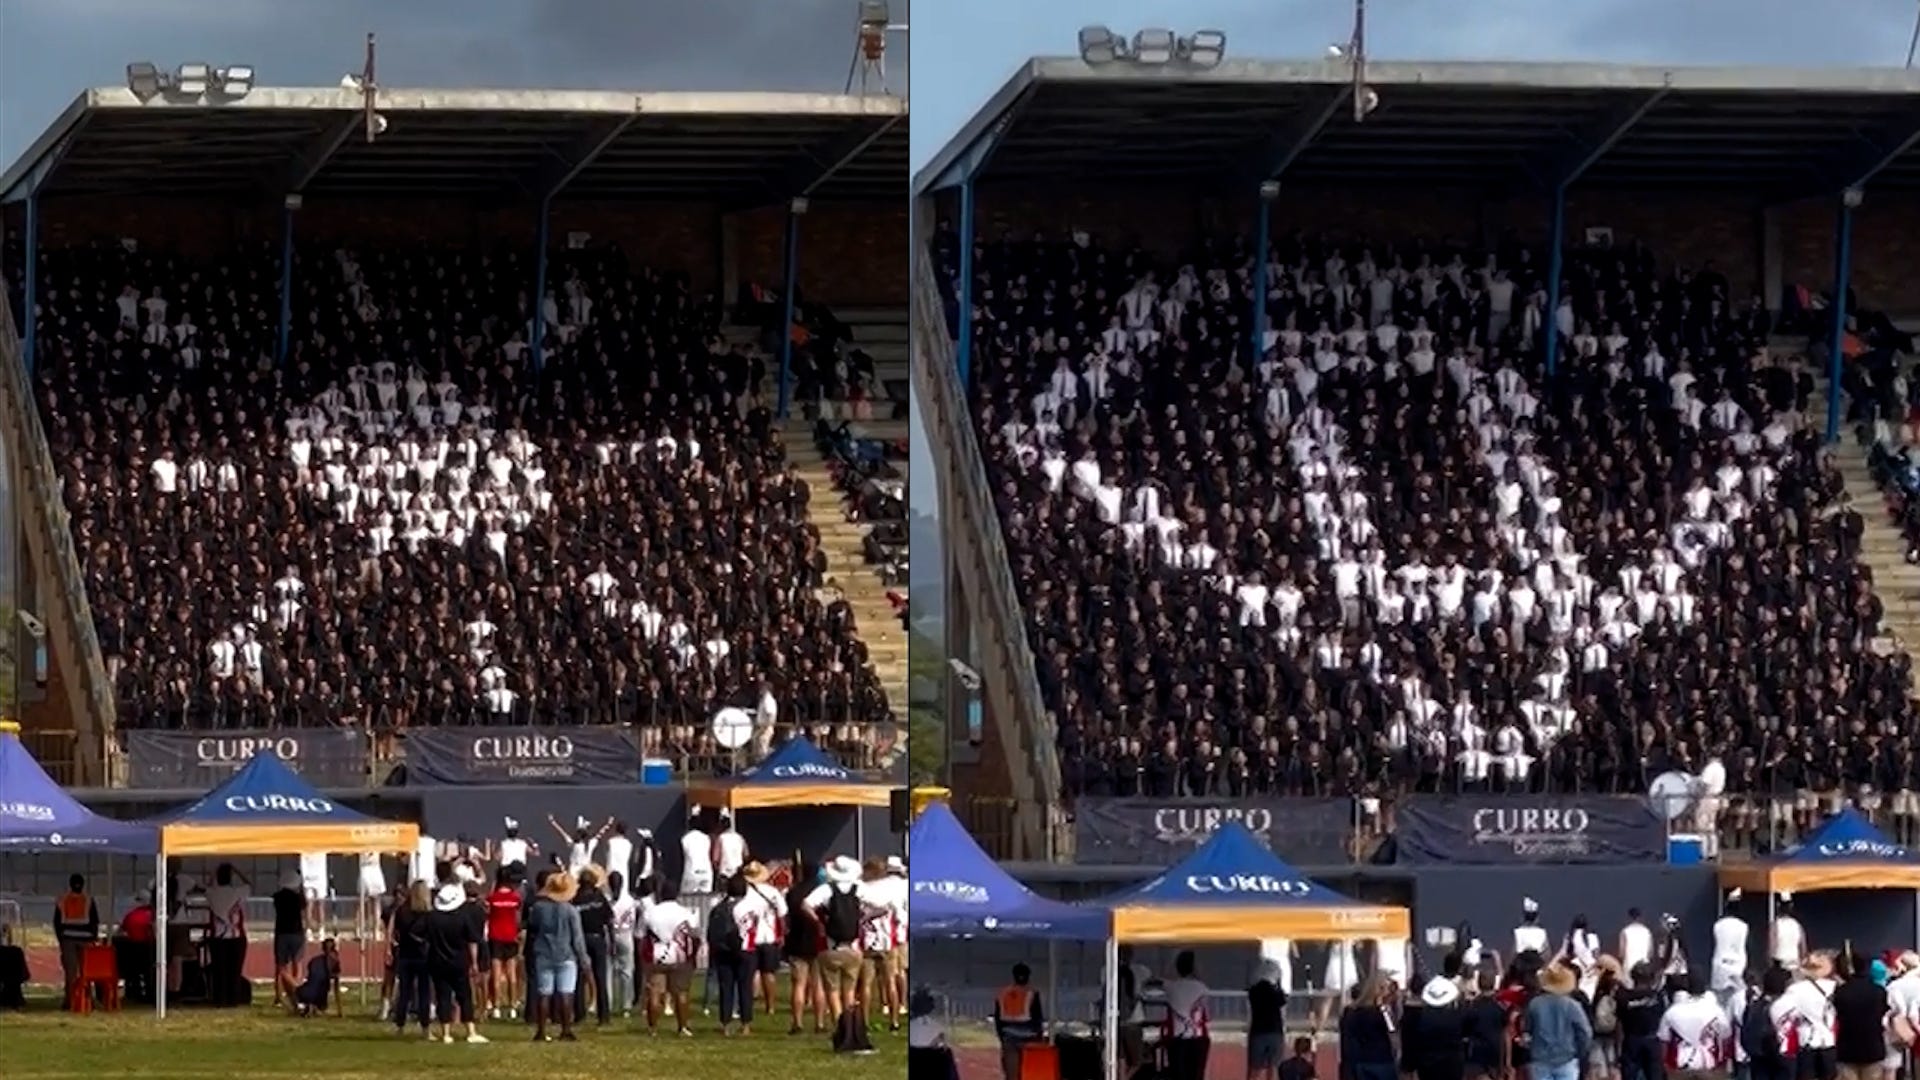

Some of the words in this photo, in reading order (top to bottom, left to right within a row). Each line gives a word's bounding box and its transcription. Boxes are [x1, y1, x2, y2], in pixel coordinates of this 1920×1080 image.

[473, 736, 573, 758] CURRO
[226, 794, 332, 813] CURRO
[1473, 808, 1588, 833] CURRO
